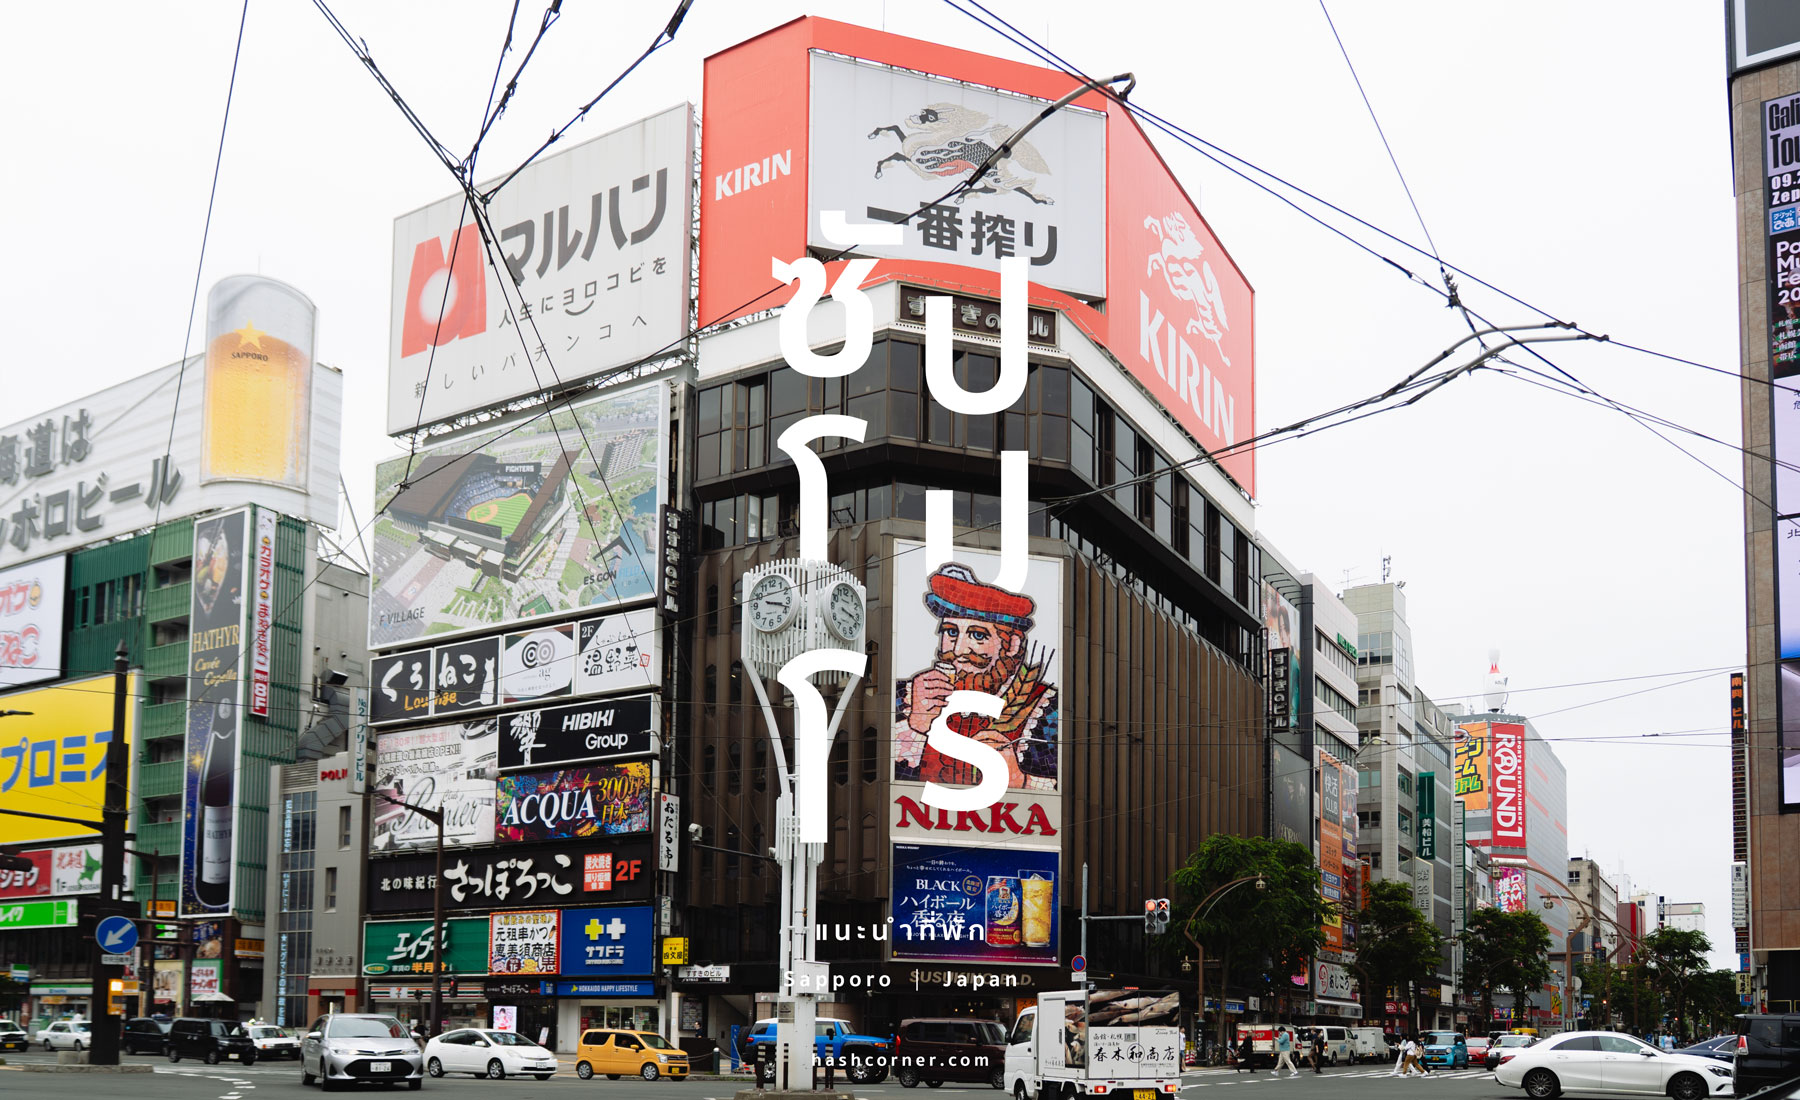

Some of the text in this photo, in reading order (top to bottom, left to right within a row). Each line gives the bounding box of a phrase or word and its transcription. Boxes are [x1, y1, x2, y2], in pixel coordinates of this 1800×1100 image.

[714, 148, 793, 202] KIRIN
[500, 167, 668, 287] マルハン
[866, 200, 1058, 267] 一番搾り
[498, 256, 668, 329] 人生にヨロコビを
[907, 295, 1050, 340] すきのル
[231, 351, 269, 362] SAPPORO
[414, 314, 648, 400] 新しいパチンコへ
[1140, 288, 1235, 455] KIRIN
[505, 464, 535, 473] FIGHTERS
[258, 545, 272, 590] カラオケ
[618, 566, 641, 579] FIELD
[379, 606, 425, 626] F VILLAGE
[192, 624, 240, 653] HATHYR
[582, 626, 594, 638] 2F
[195, 656, 220, 672] Cuvée
[204, 670, 238, 686] Capella
[380, 652, 476, 702] くろねこ
[1274, 652, 1288, 728] すすきのビル
[405, 692, 457, 712] Lounge
[561, 709, 615, 732] HIBIKI
[585, 733, 628, 750] Group
[1325, 772, 1338, 798] 快活
[501, 788, 597, 829] ACQUA
[601, 802, 643, 826] 日本一
[894, 794, 1058, 836] NIKKA
[1325, 796, 1338, 815] CLUB
[444, 854, 573, 902] さっぽろっこ
[616, 860, 642, 881] 2F
[380, 875, 438, 892] 北の味紀行
[915, 879, 961, 892] BLACK
[1511, 874, 1522, 902] DAM
[900, 894, 975, 911] ハイボール
[910, 910, 965, 930] 香る夜
[495, 926, 548, 942] 元祖串かつ
